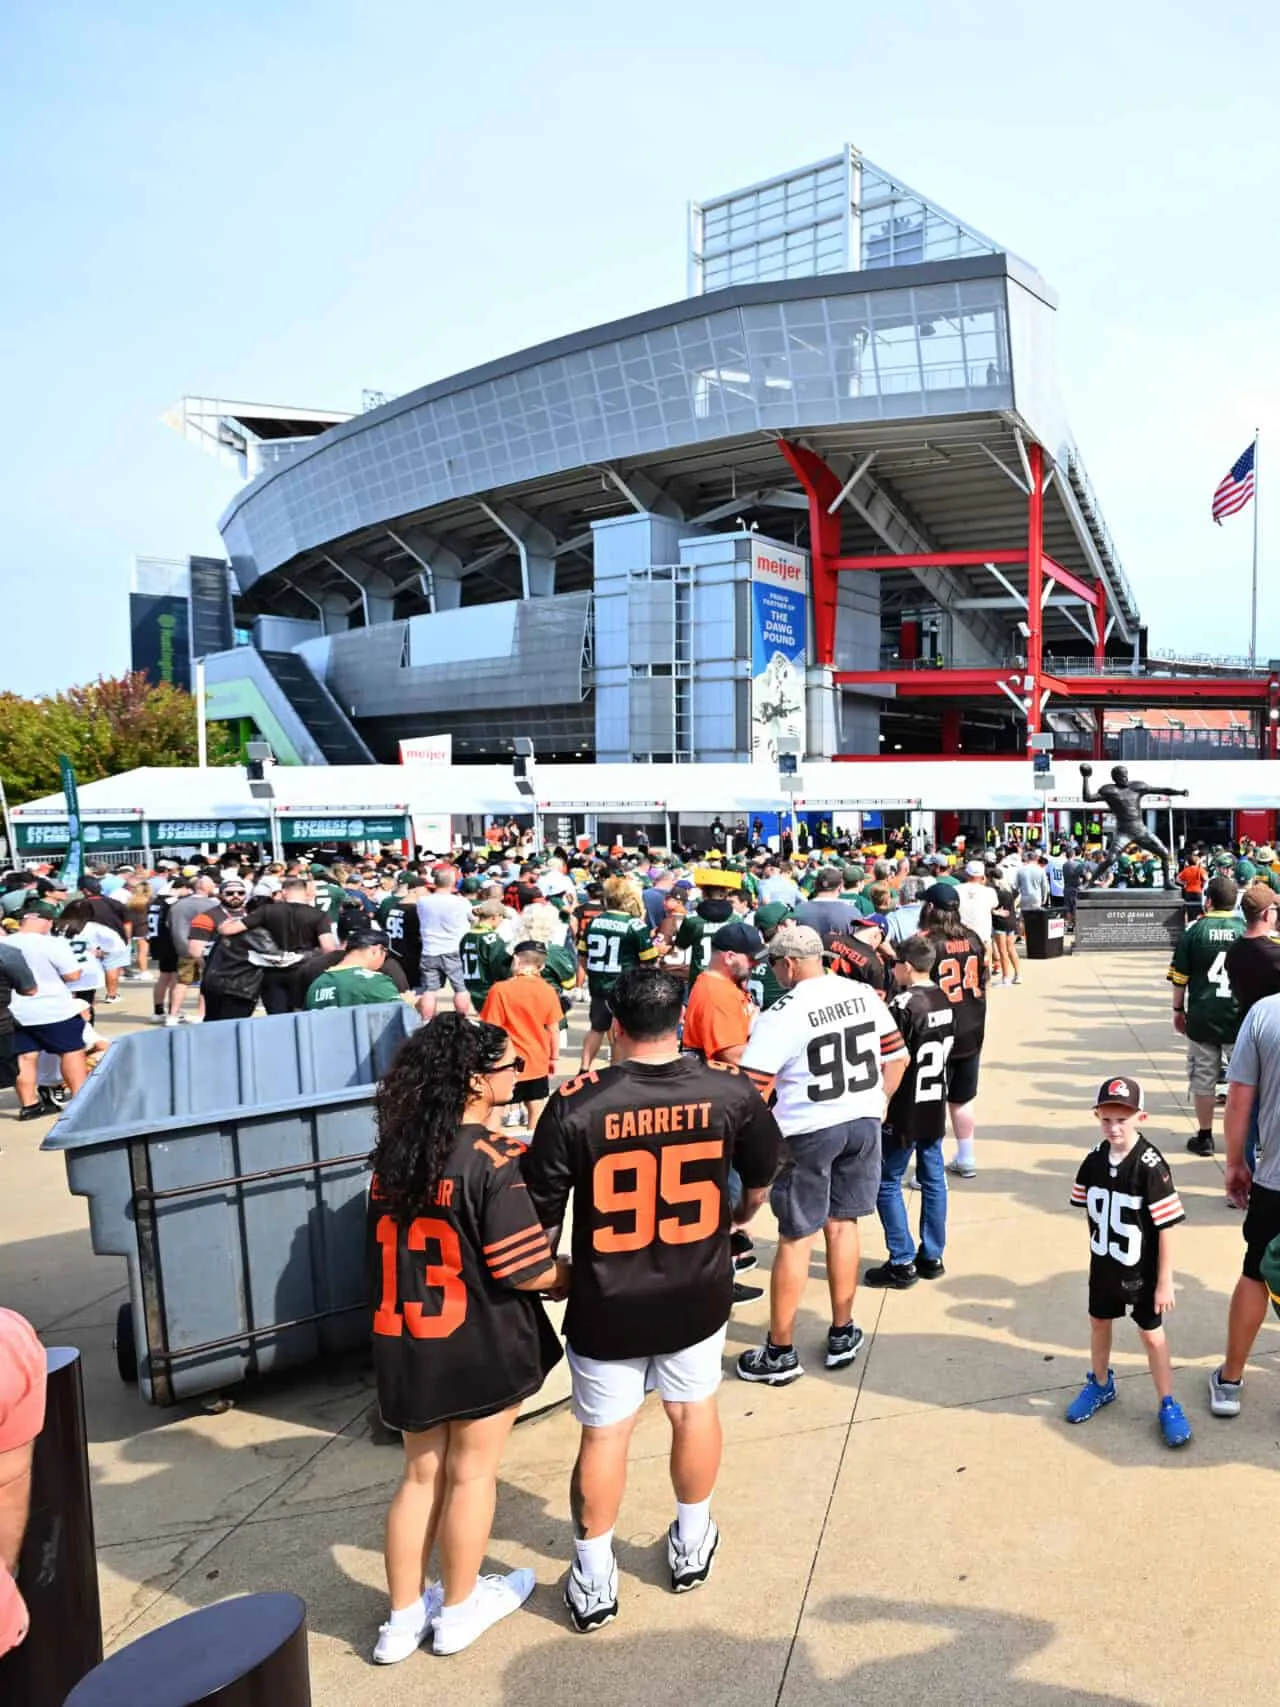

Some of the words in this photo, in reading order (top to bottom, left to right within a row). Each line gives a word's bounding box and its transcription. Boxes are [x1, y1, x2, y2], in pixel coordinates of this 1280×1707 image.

[757, 554, 801, 581] meijer
[765, 620, 793, 635] DAWG
[770, 610, 789, 623] THE
[762, 630, 796, 647] POUND
[587, 934, 622, 973] 21
[1209, 929, 1236, 942] FAVRE
[938, 955, 983, 1004] 24
[1208, 951, 1233, 998] 4
[807, 997, 867, 1029] GARRETT
[807, 1021, 879, 1102] 95
[604, 1103, 711, 1141] GARRETT
[592, 1140, 724, 1254] 95
[1087, 1186, 1143, 1267] 95
[373, 1214, 468, 1339] 13
